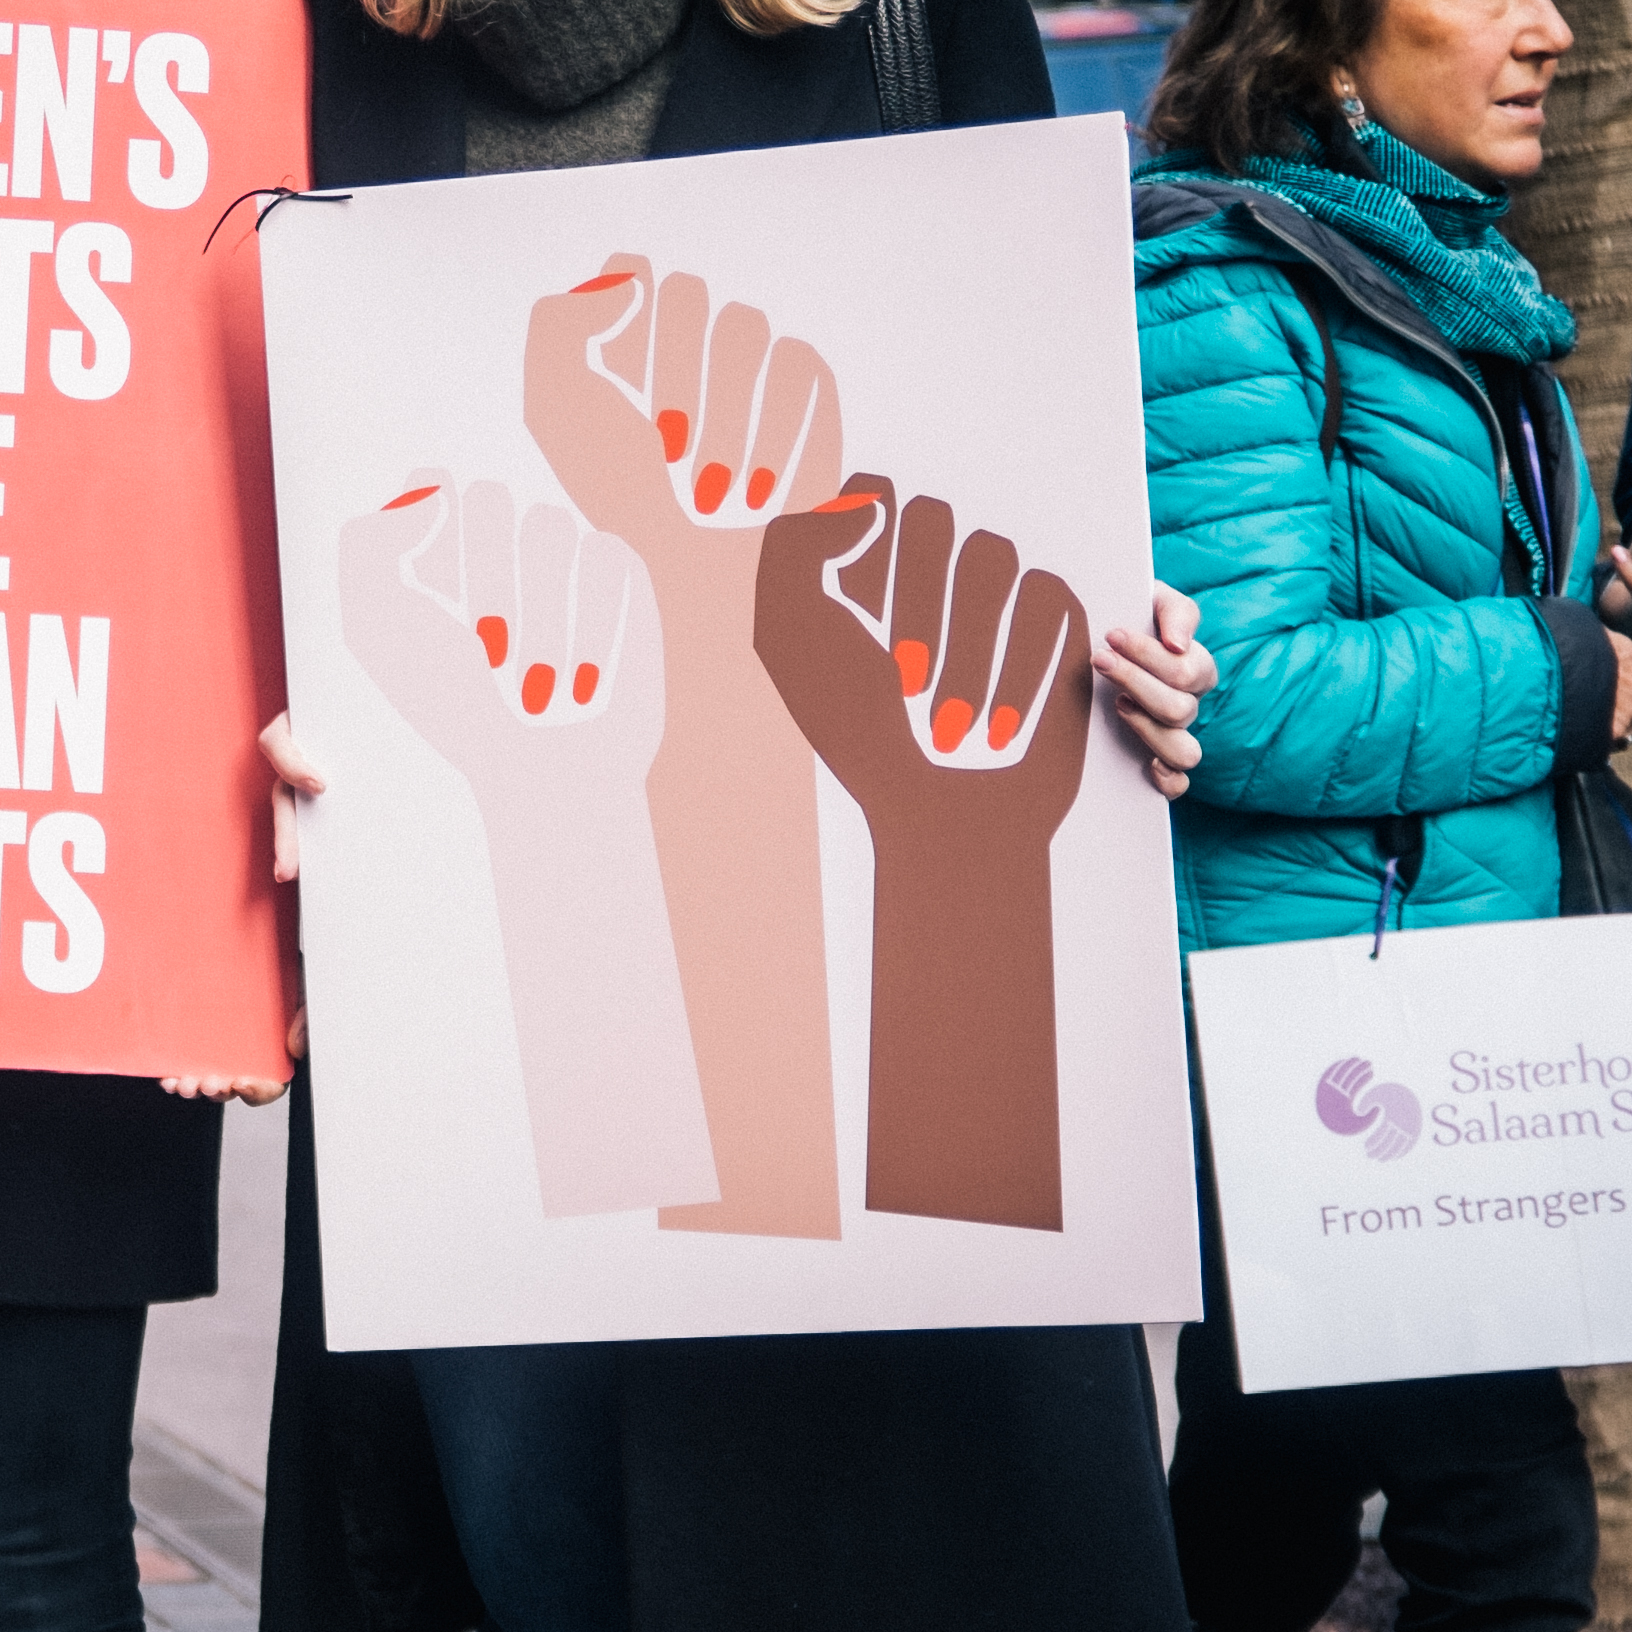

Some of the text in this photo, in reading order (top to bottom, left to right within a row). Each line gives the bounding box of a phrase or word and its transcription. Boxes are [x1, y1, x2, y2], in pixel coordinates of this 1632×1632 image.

[1448, 1042, 1632, 1094] Sisterho
[1430, 1100, 1604, 1147] Salaam
[1319, 1188, 1628, 1237] From Strangers
